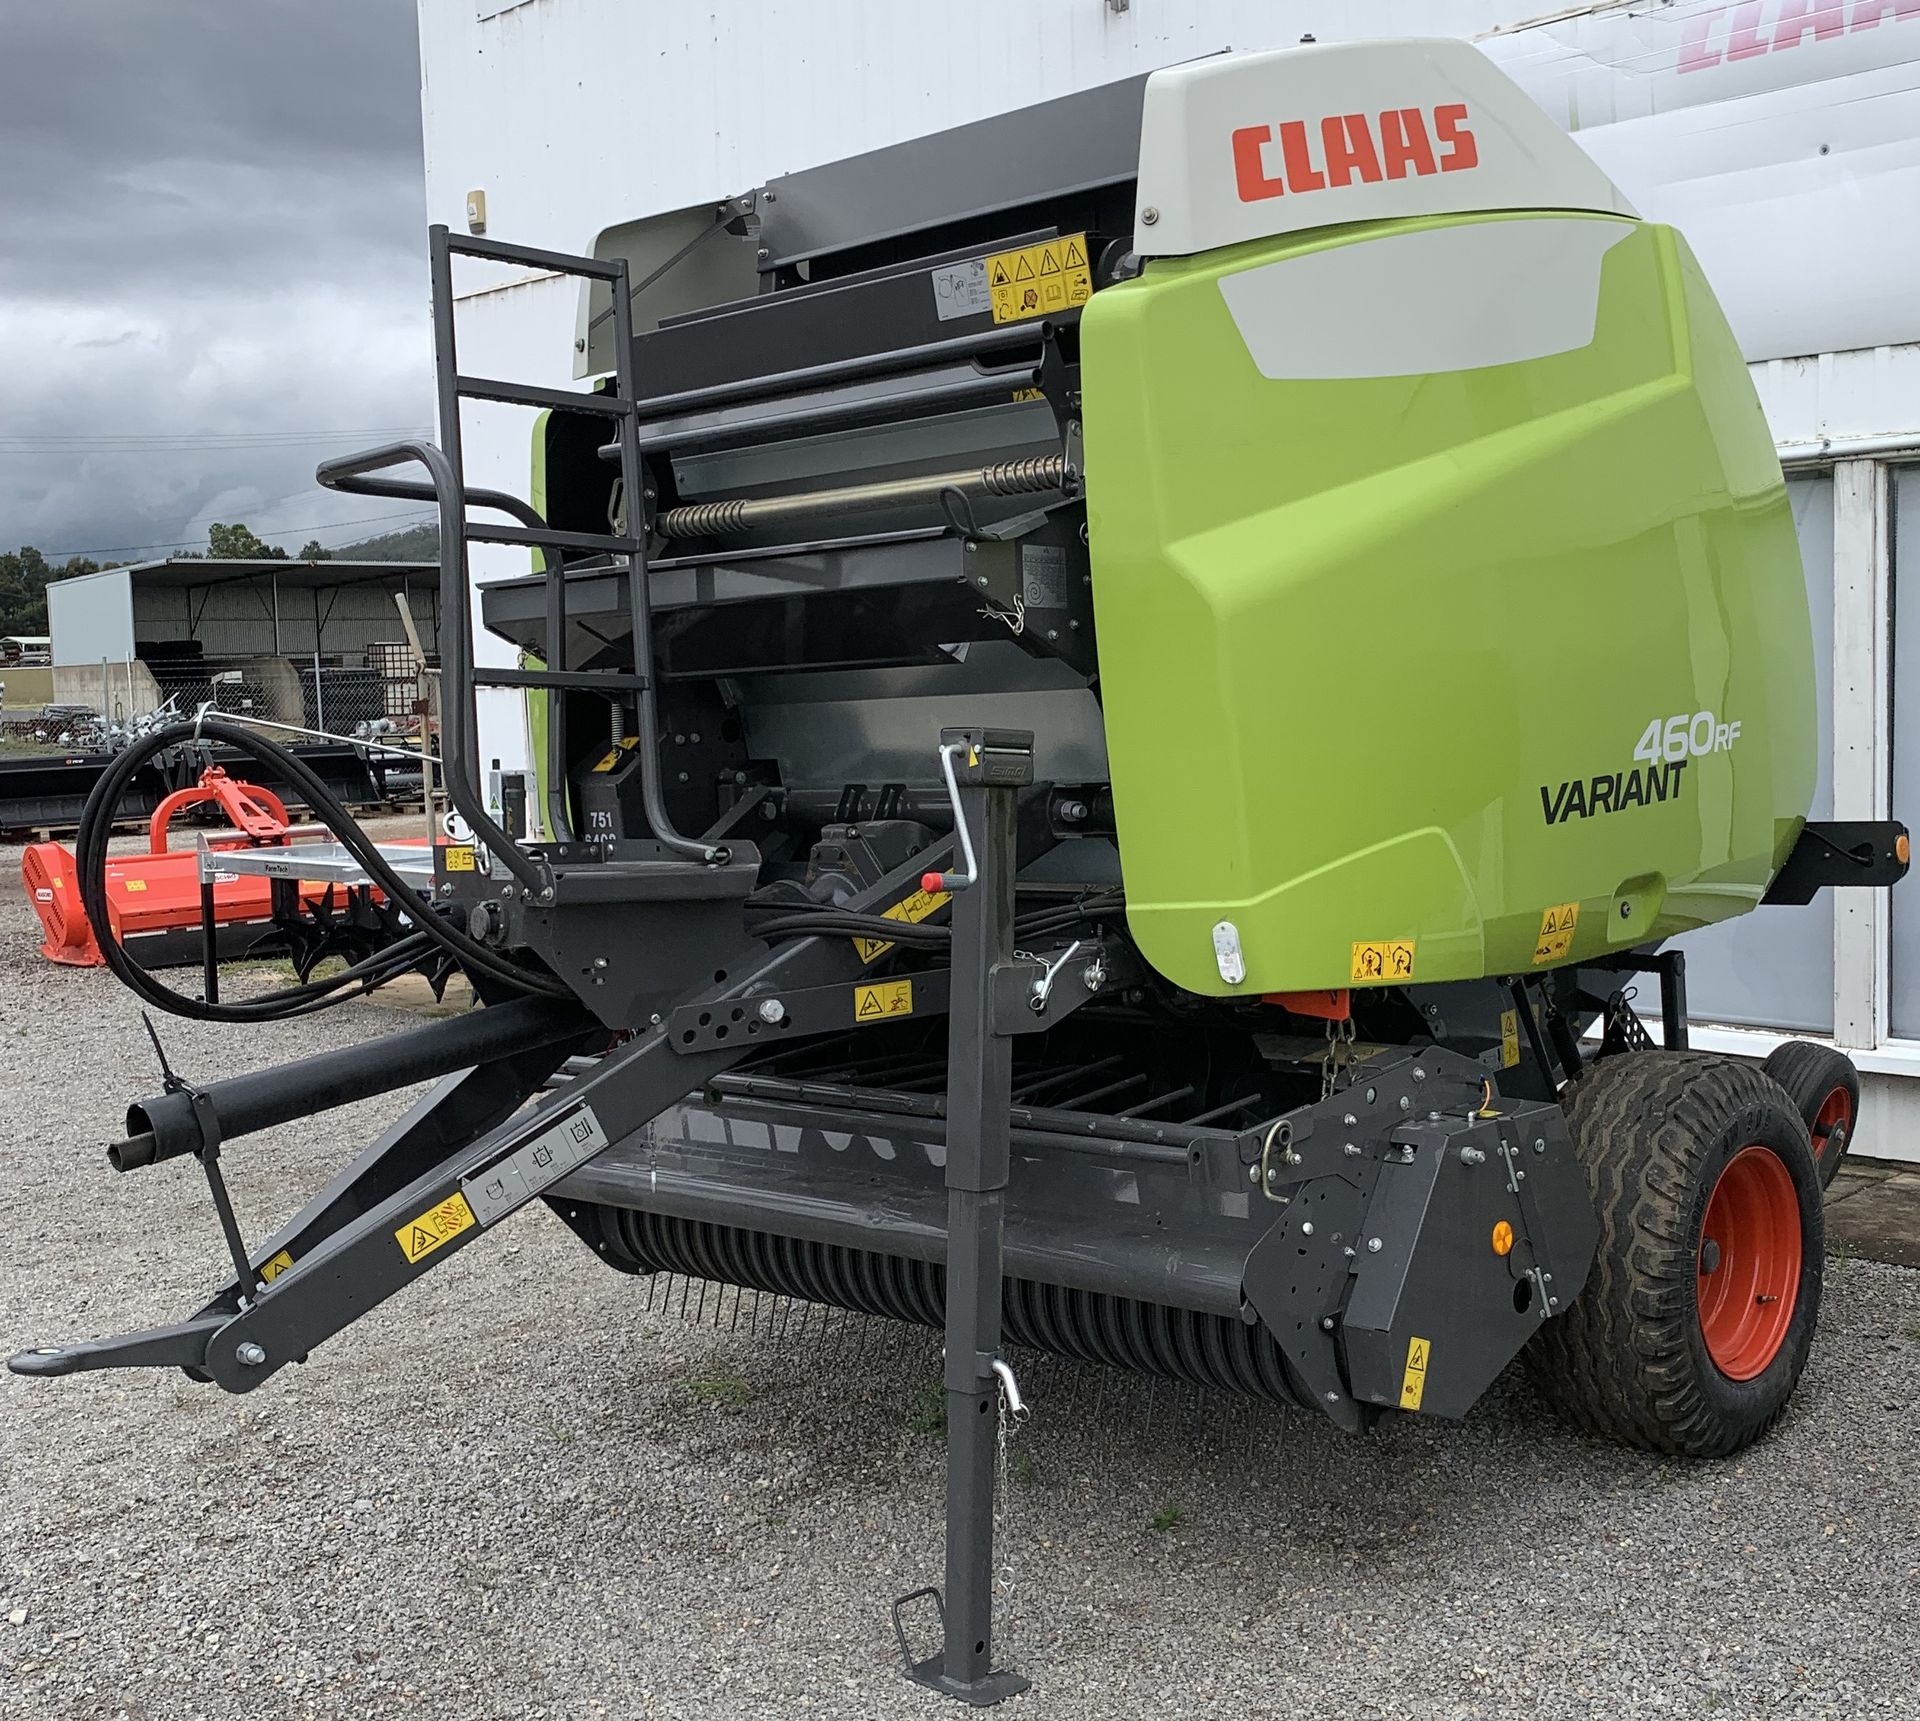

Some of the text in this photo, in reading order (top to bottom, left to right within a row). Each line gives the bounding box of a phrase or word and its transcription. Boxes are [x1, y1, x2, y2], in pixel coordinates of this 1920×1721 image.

[1231, 103, 1479, 204] CLAAS
[590, 811, 612, 829] 751
[1539, 759, 1688, 826] VARIANT
